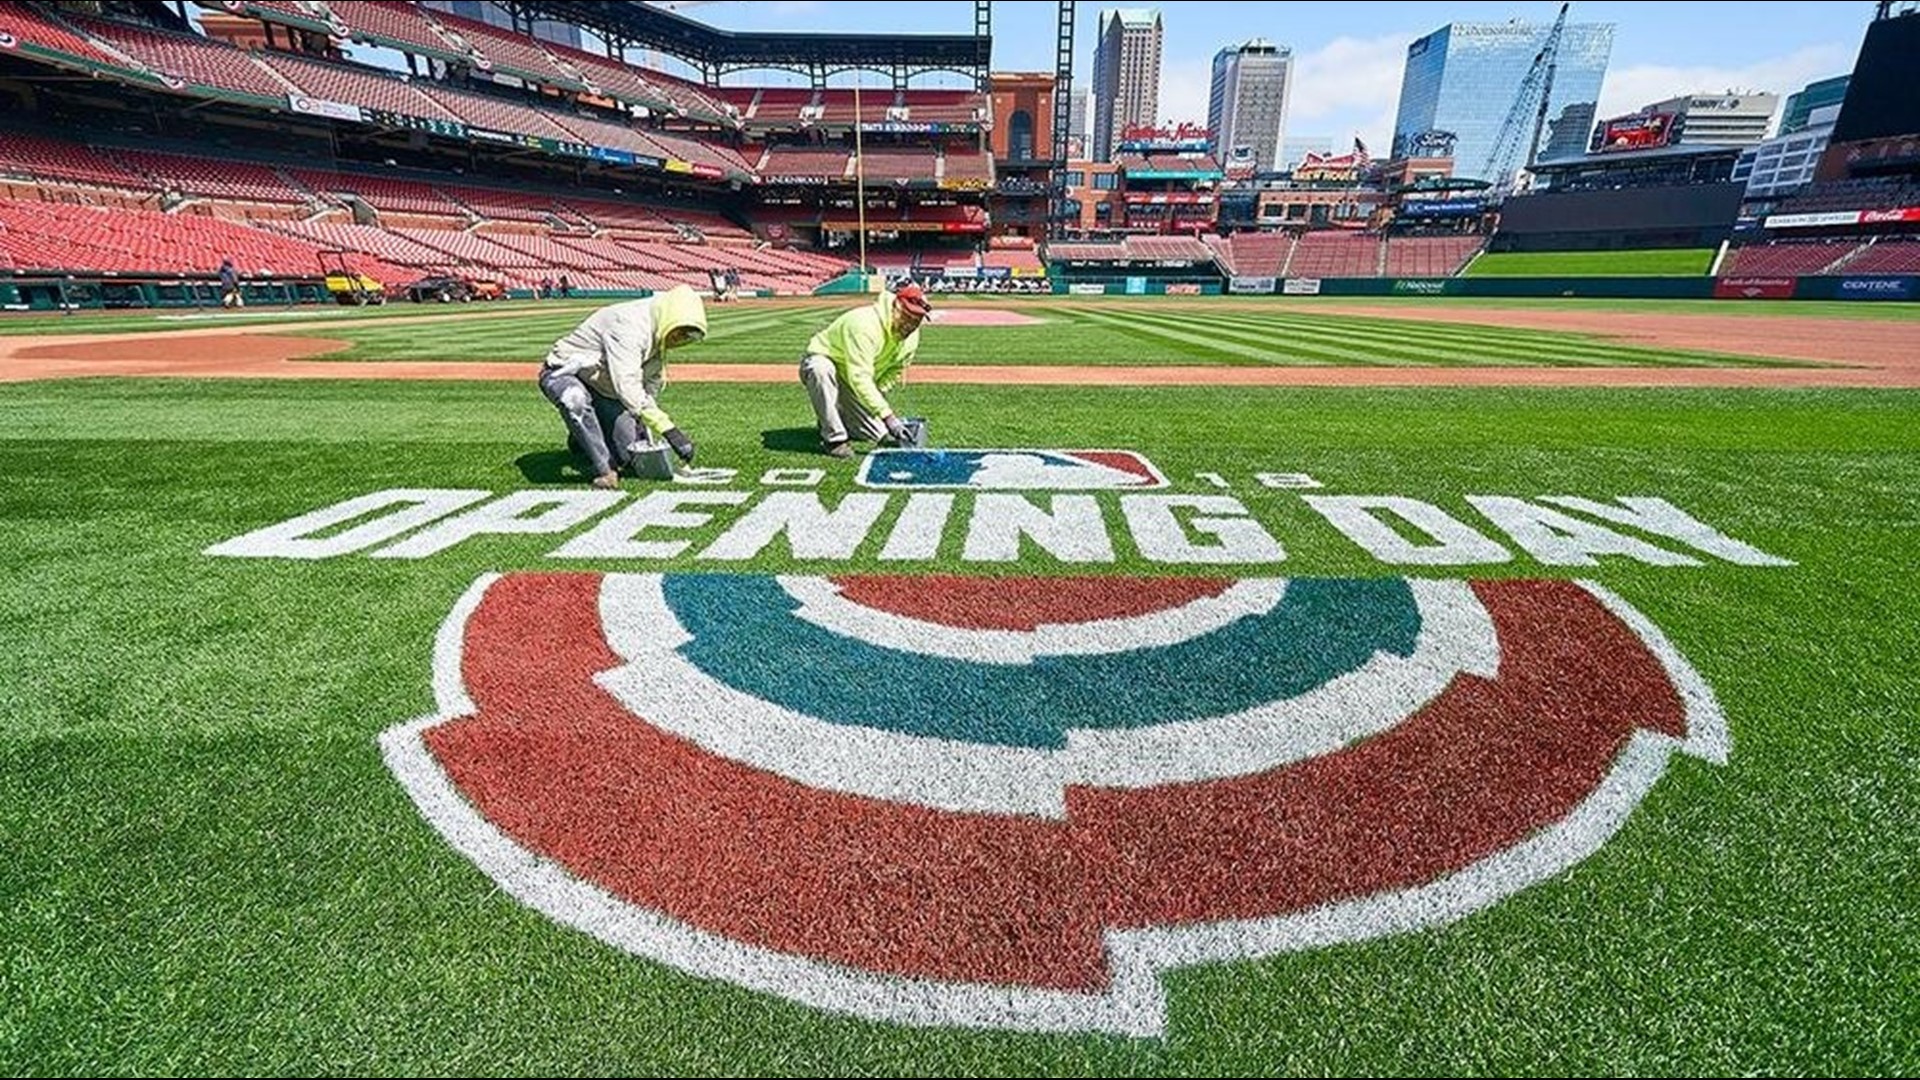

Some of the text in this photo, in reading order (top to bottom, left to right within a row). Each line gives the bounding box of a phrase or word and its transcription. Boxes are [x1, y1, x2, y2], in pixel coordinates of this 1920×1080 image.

[1420, 133, 1452, 147] Ford
[1753, 278, 1790, 286] America
[1842, 280, 1903, 290] CENTENE
[204, 489, 1797, 568] OPENING DAY
